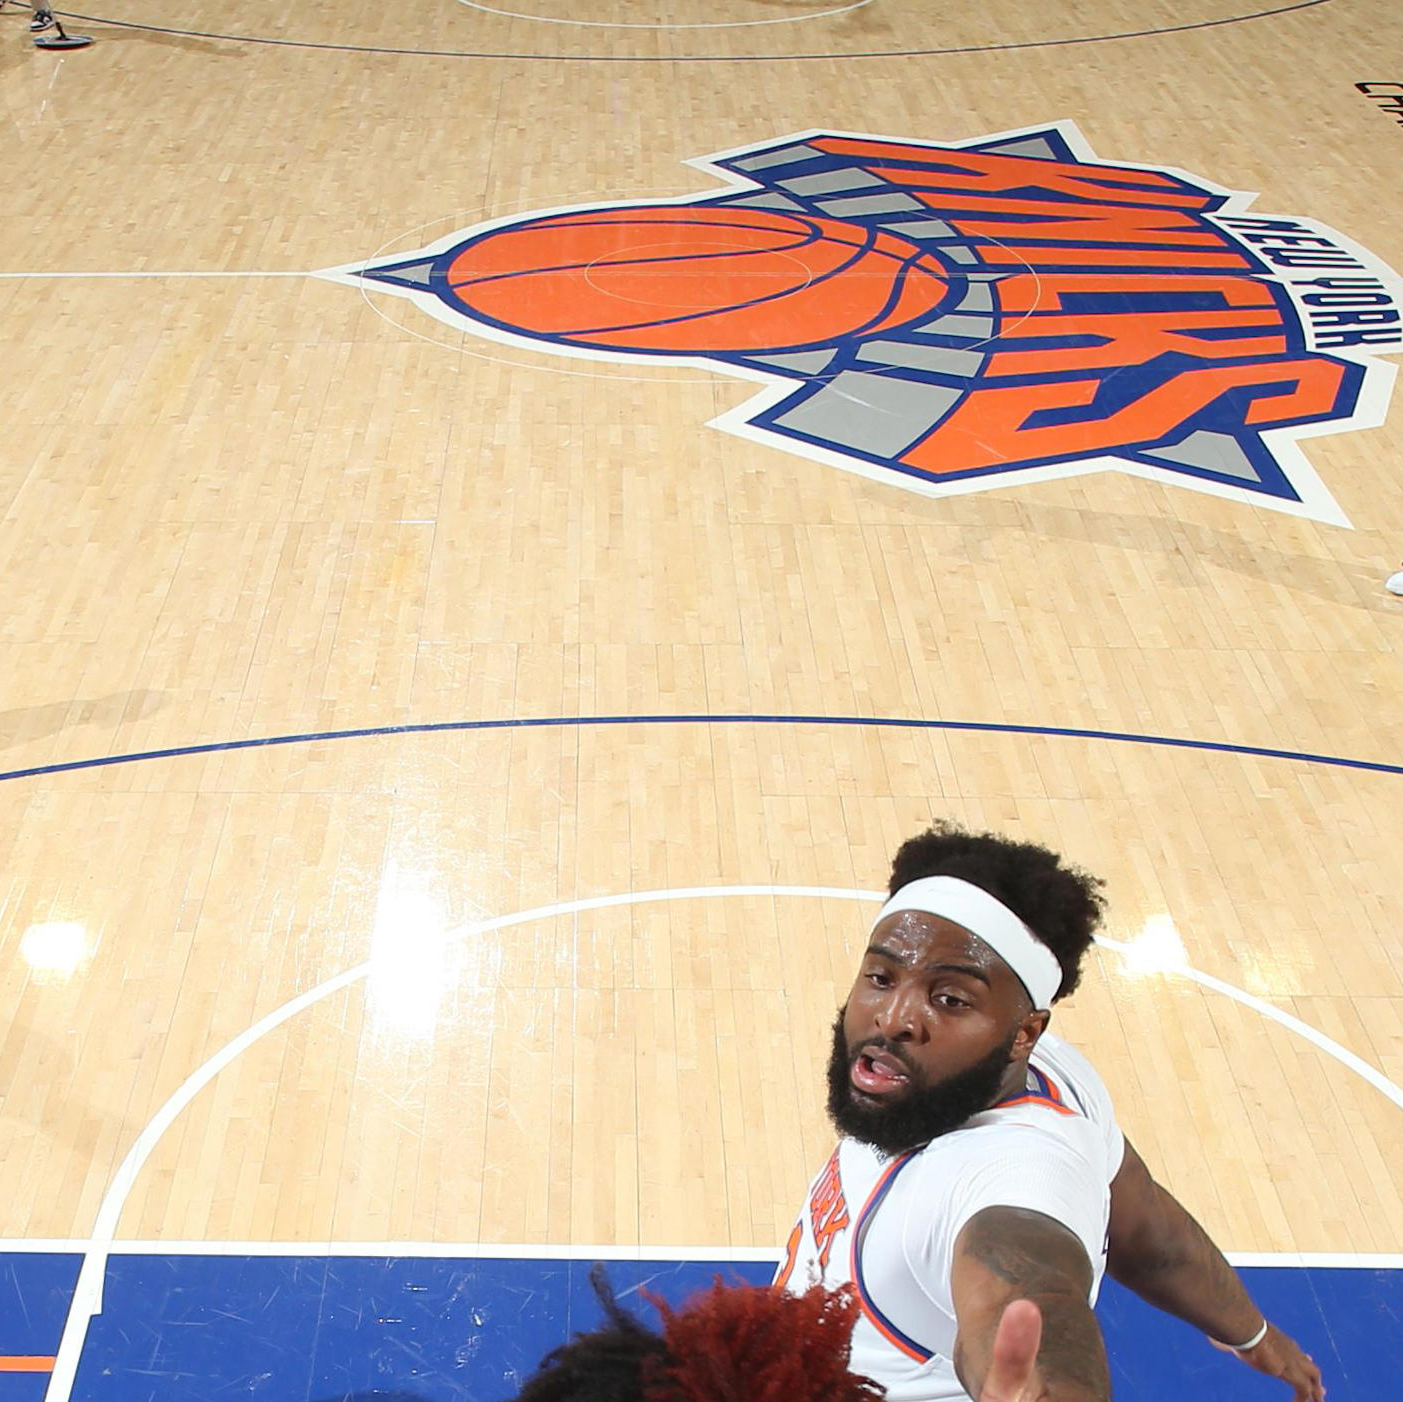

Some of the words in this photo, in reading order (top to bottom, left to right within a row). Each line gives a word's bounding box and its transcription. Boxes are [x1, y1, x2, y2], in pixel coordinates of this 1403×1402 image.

[807, 137, 1345, 475] KNICKS
[1212, 216, 1367, 270] NEW
[1290, 278, 1403, 349] YORK
